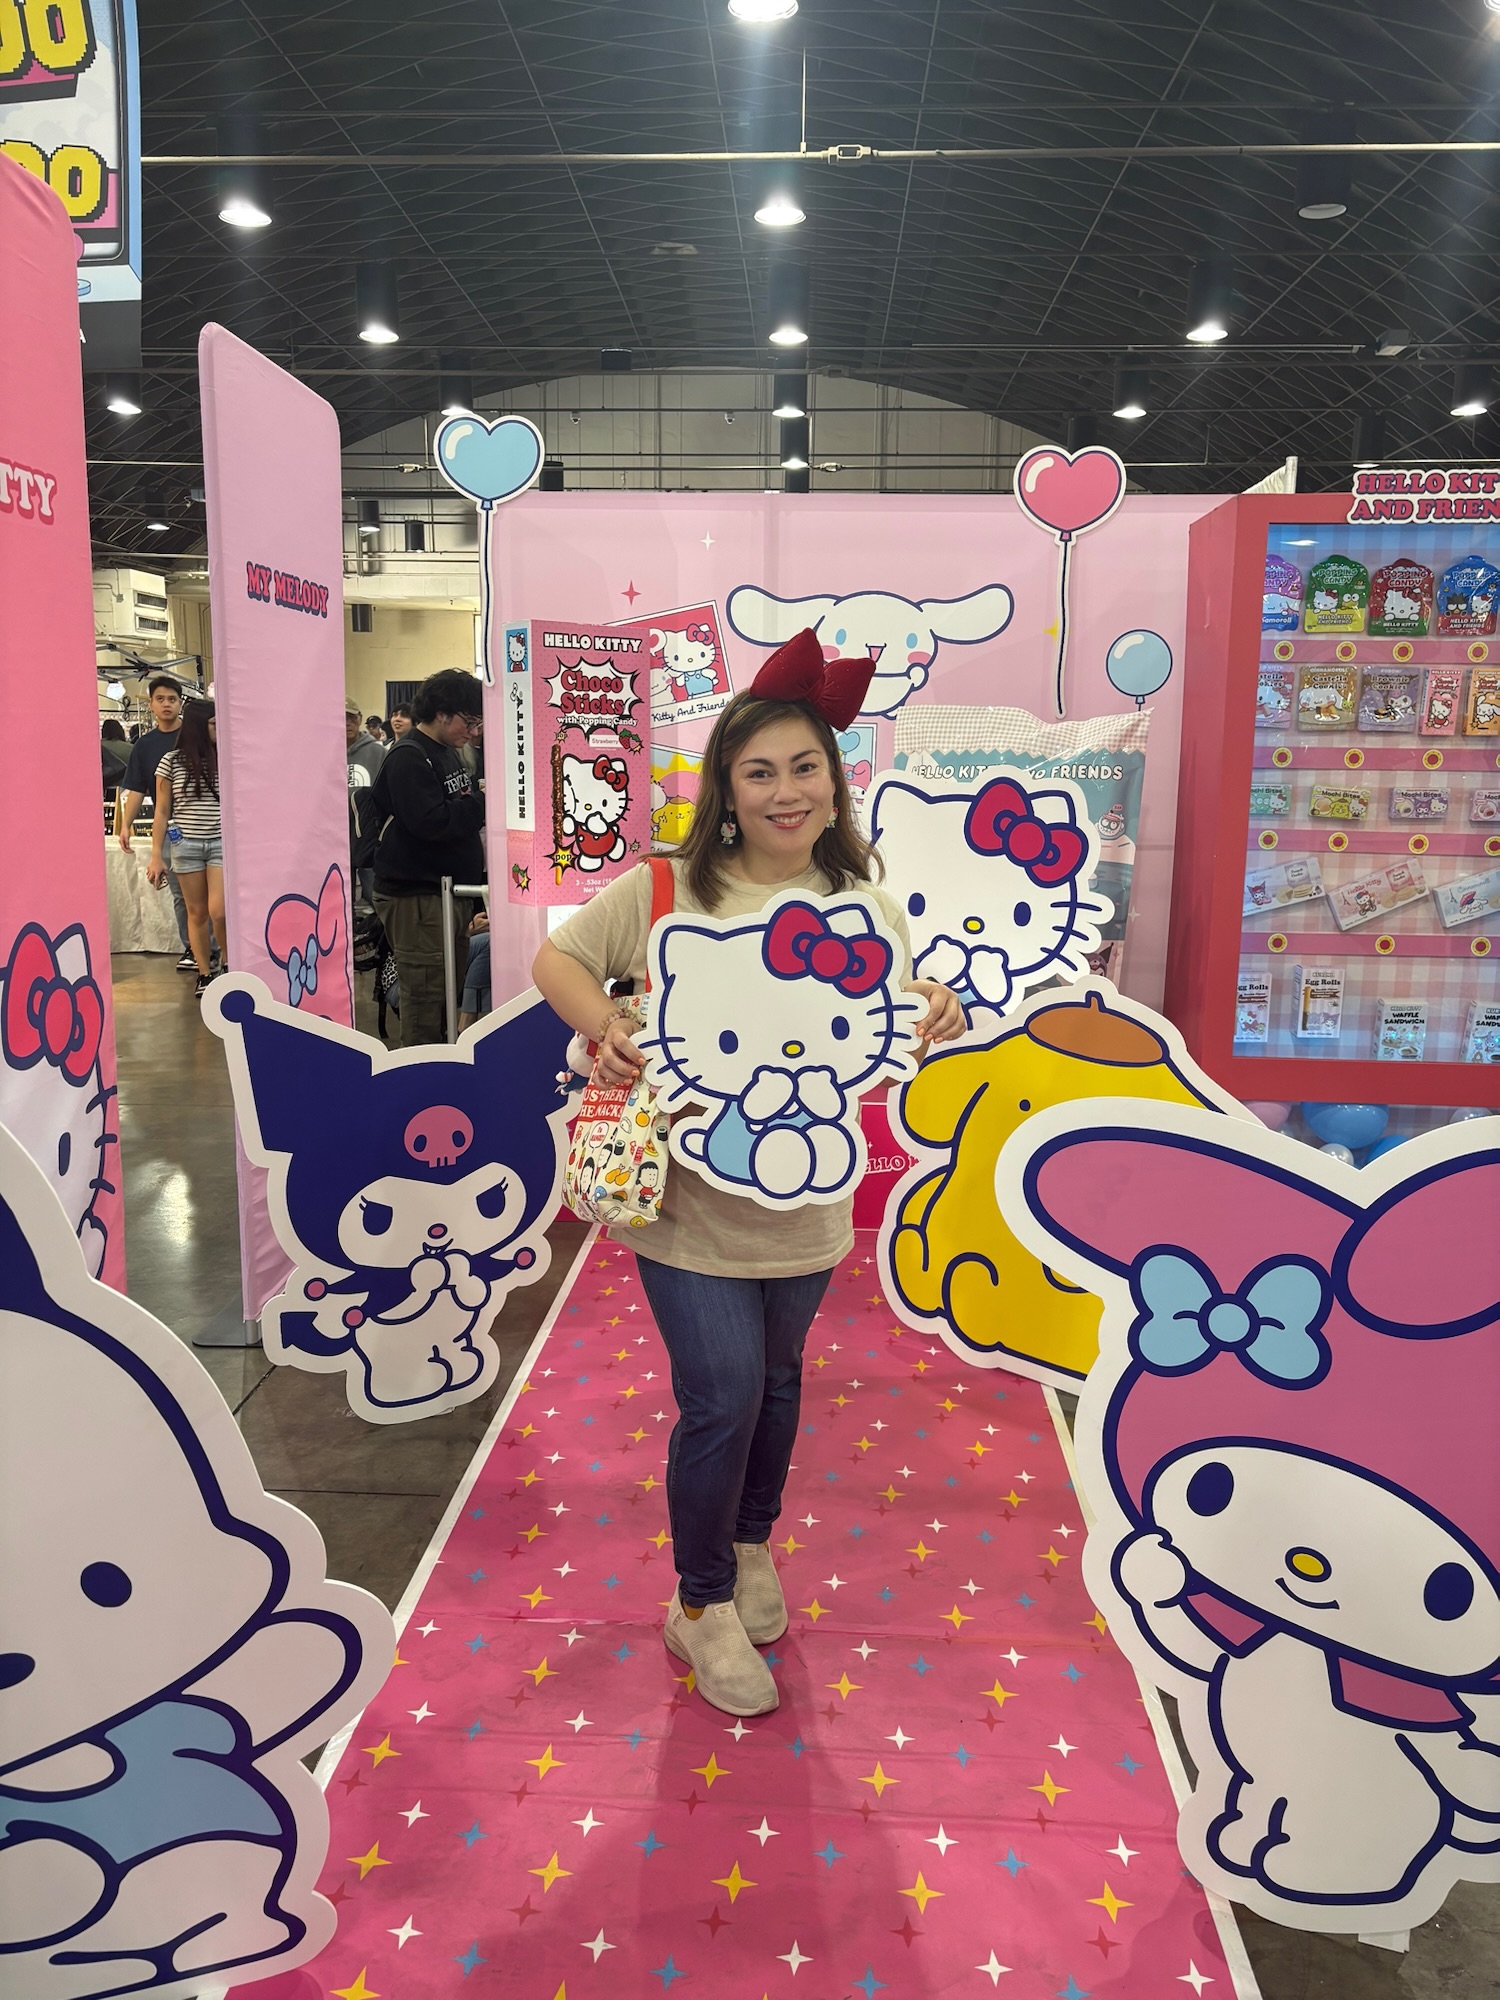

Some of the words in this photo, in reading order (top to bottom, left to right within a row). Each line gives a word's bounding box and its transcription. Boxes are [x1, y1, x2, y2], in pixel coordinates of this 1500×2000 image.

[1357, 473, 1445, 494] HELLO
[1351, 499, 1413, 519] AND
[1416, 498, 1500, 519] FRIEN
[247, 562, 271, 601] MY
[274, 571, 328, 616] MELODY
[543, 632, 592, 650] HELLO
[593, 636, 642, 653] KITTY
[561, 669, 624, 693] Choco
[560, 692, 625, 715] Sticks
[651, 713, 675, 722] Kitty
[677, 705, 696, 717] And
[557, 716, 577, 725] with
[579, 716, 611, 728] Popping
[613, 717, 638, 727] Candy
[591, 737, 619, 745] Strawberry
[1050, 764, 1124, 781] FRIENDS
[516, 761, 526, 819] HELLO
[555, 852, 572, 861] pop
